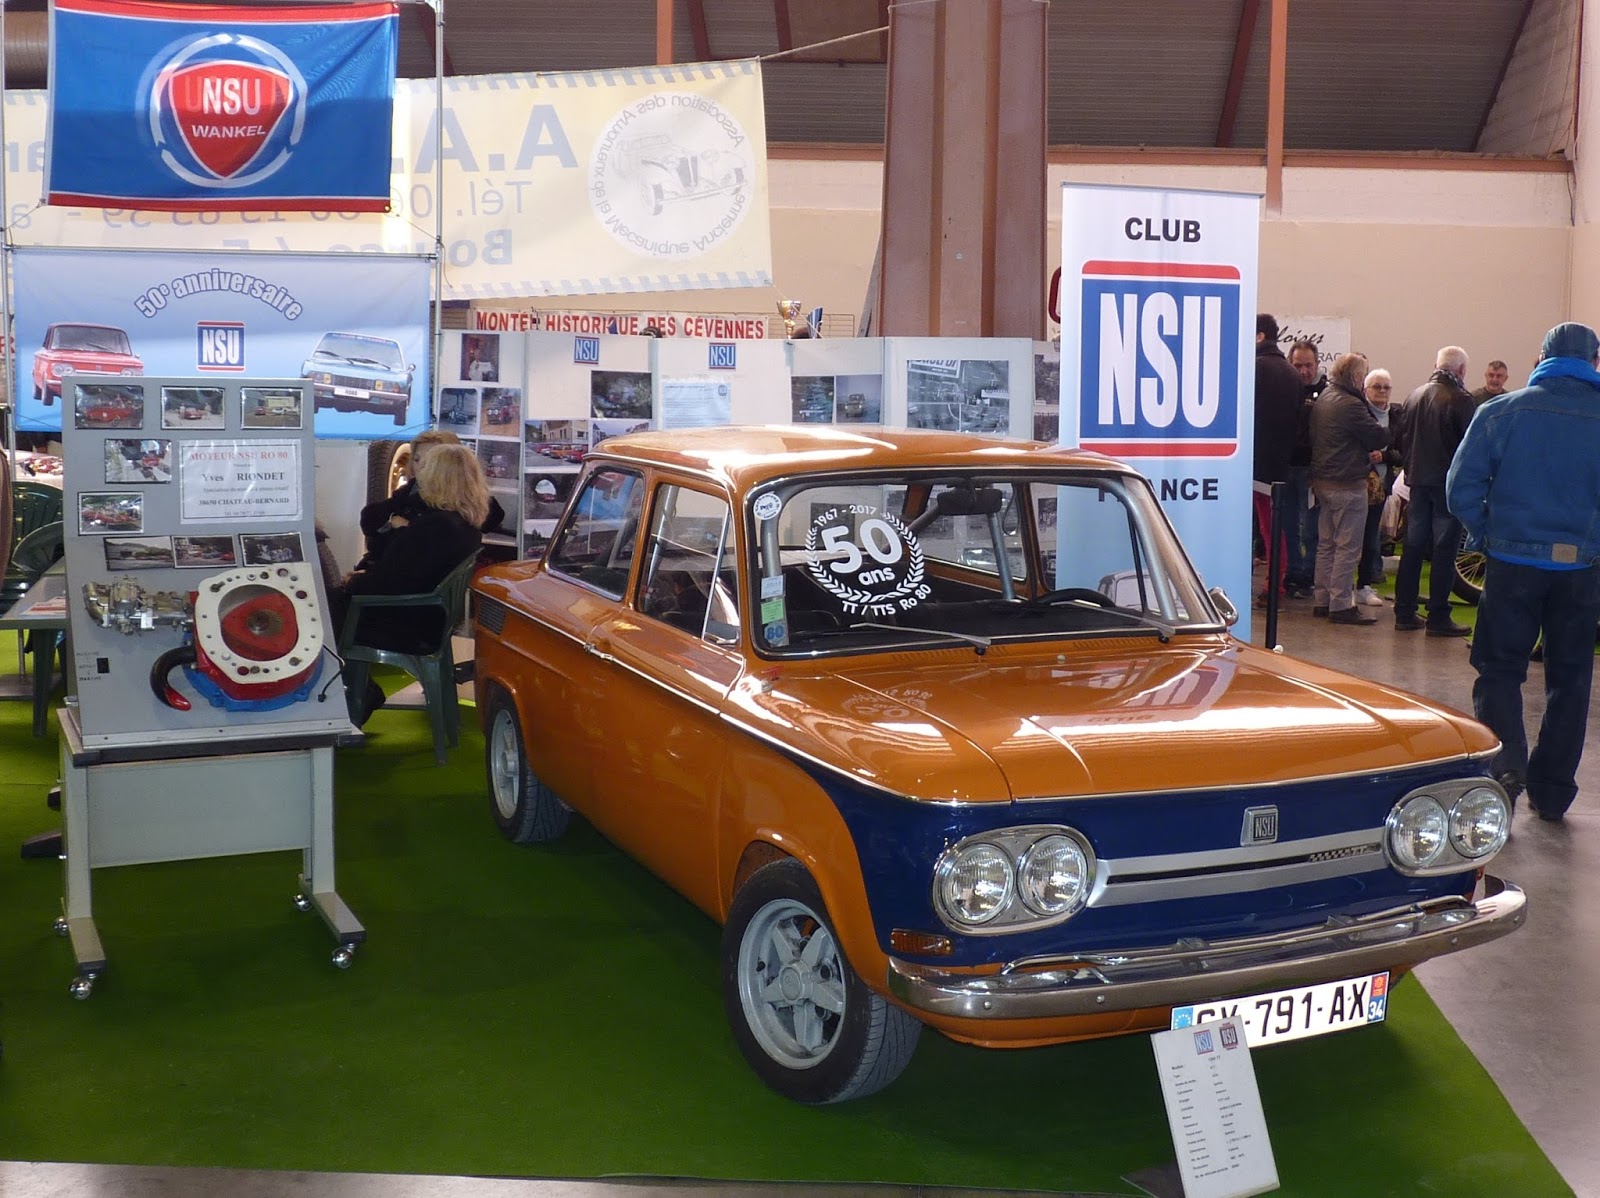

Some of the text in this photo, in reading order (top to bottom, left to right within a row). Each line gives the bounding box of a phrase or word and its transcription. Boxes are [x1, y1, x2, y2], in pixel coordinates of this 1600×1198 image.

[202, 77, 262, 115] NSU
[191, 124, 266, 138] WANKEL
[1124, 217, 1202, 243] CLUB
[171, 268, 303, 321] anniversaire
[684, 315, 764, 339] CÉVENNES
[202, 329, 240, 364] NSU
[575, 338, 598, 360] NSU
[710, 346, 734, 366] NSU
[1098, 292, 1222, 428] NSU
[190, 451, 234, 461] MOTEUR
[261, 451, 276, 460] RO
[277, 451, 288, 460] 80
[201, 472, 285, 482] Yves RIONDET
[814, 508, 839, 528] 1967
[849, 504, 877, 515] 2017
[821, 518, 902, 574] 50
[858, 567, 896, 586] ans
[842, 600, 858, 614] TT
[871, 603, 896, 616] TTS
[899, 597, 918, 611] Ro
[915, 584, 932, 600] 80
[1255, 815, 1276, 838] NSU
[1368, 999, 1383, 1020] 34
[1195, 1033, 1213, 1051] NSU
[1222, 1028, 1237, 1046] NSU
